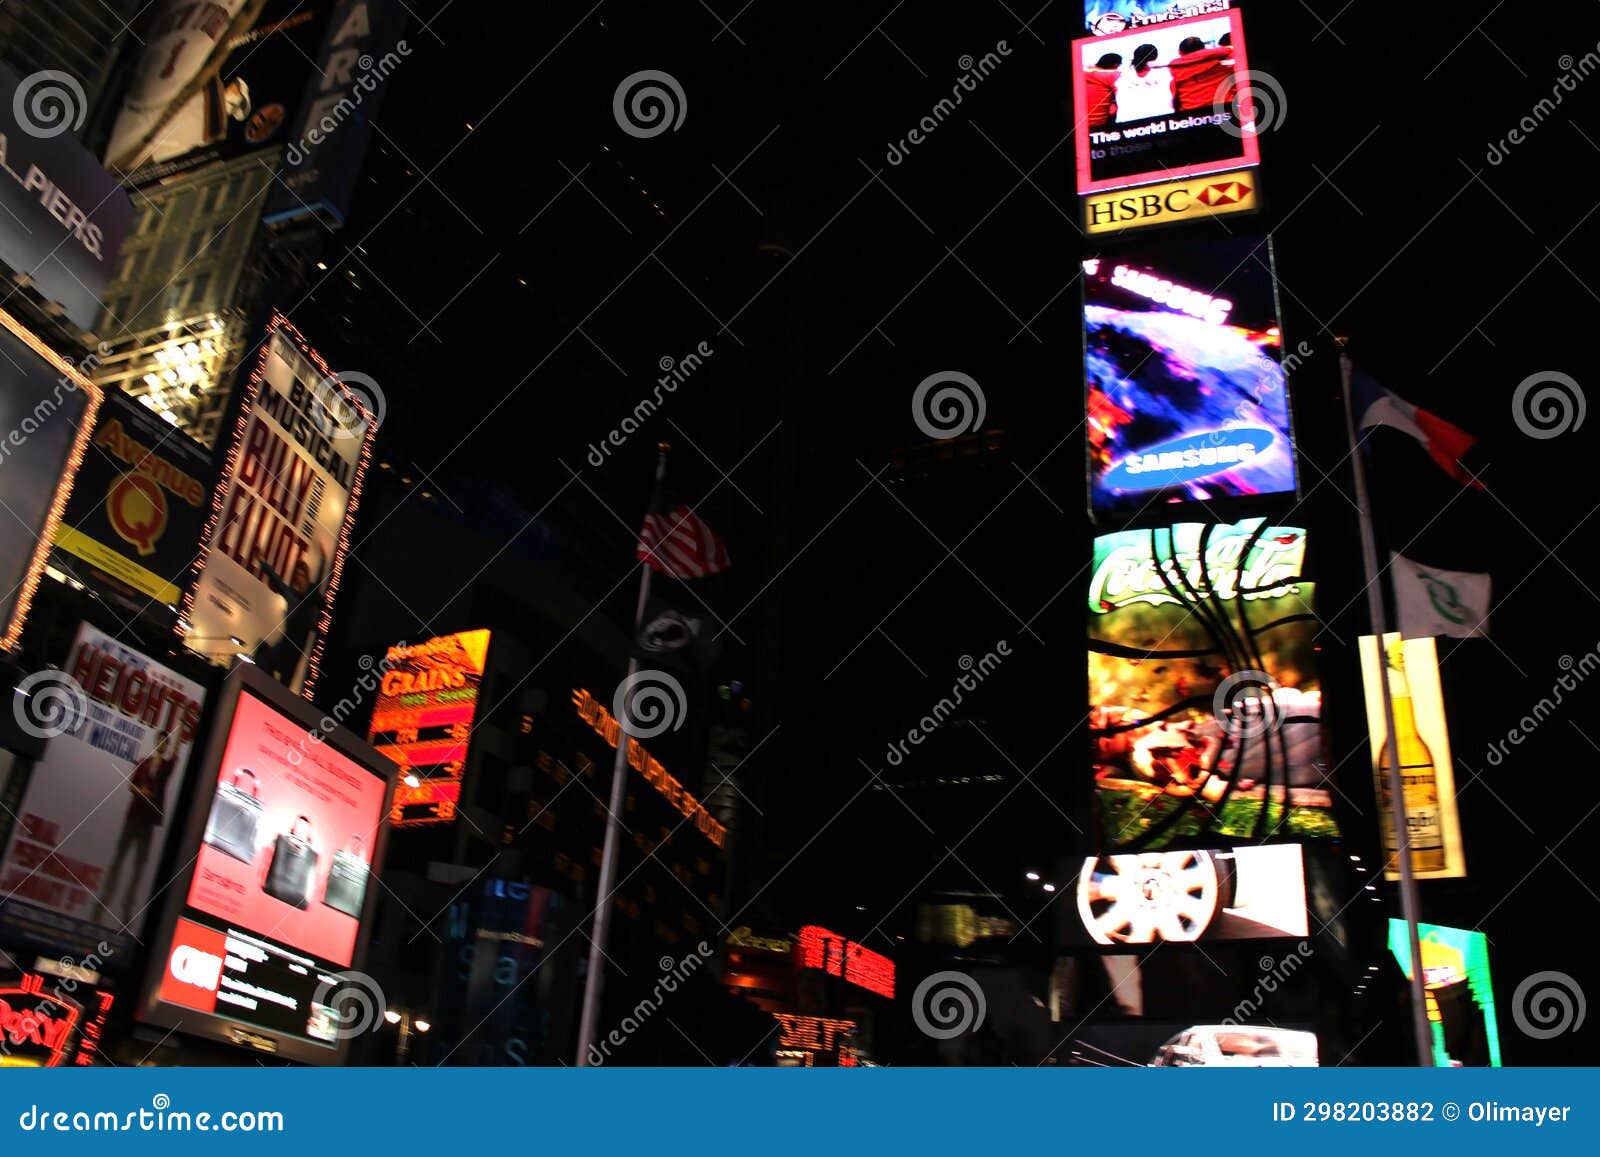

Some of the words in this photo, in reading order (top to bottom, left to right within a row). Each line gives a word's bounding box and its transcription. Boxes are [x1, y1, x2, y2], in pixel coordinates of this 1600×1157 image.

[1090, 131, 1121, 145] The
[1123, 120, 1167, 139] world
[1168, 111, 1233, 131] belongs
[1091, 149, 1106, 160] to
[1088, 189, 1192, 226] HSBC
[95, 417, 206, 508] Avenue
[256, 379, 350, 491] MUSICAL
[1125, 443, 1256, 475] SAMSUNG
[239, 414, 318, 527] BILLY
[105, 468, 169, 557] Q
[72, 642, 201, 743] HEIGHTS
[381, 669, 466, 698] GRAINS
